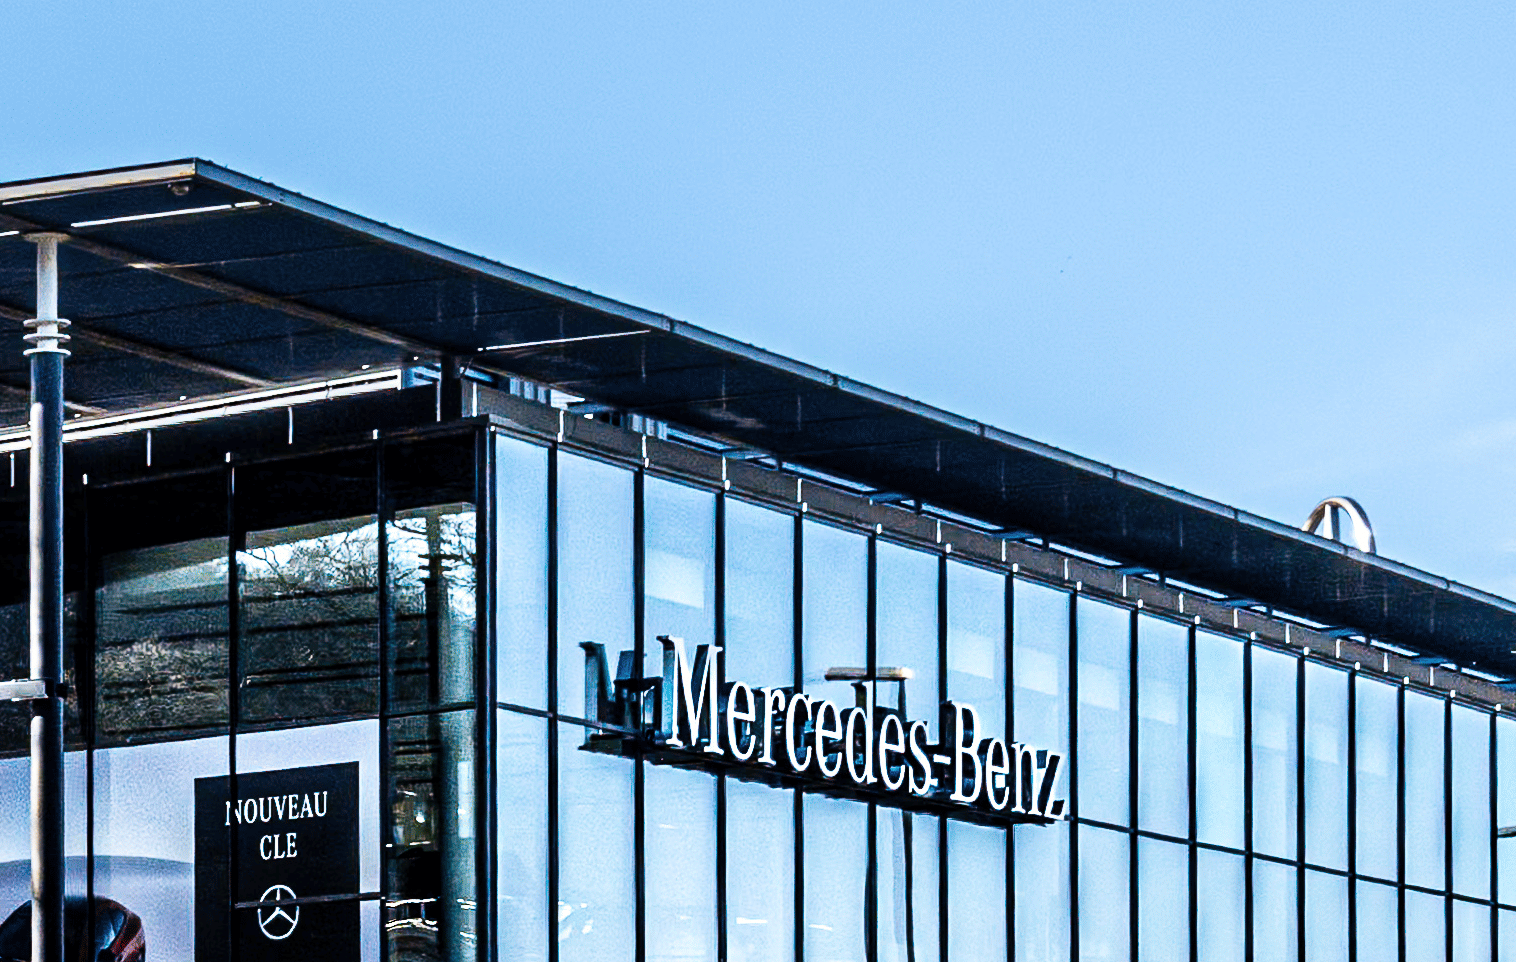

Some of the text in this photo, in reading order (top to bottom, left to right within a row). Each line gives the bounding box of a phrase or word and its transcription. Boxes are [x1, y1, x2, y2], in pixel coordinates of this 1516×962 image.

[664, 635, 1067, 822] Mercedes-Benz
[225, 791, 328, 826] NOUVEAU
[260, 832, 298, 861] CLE
